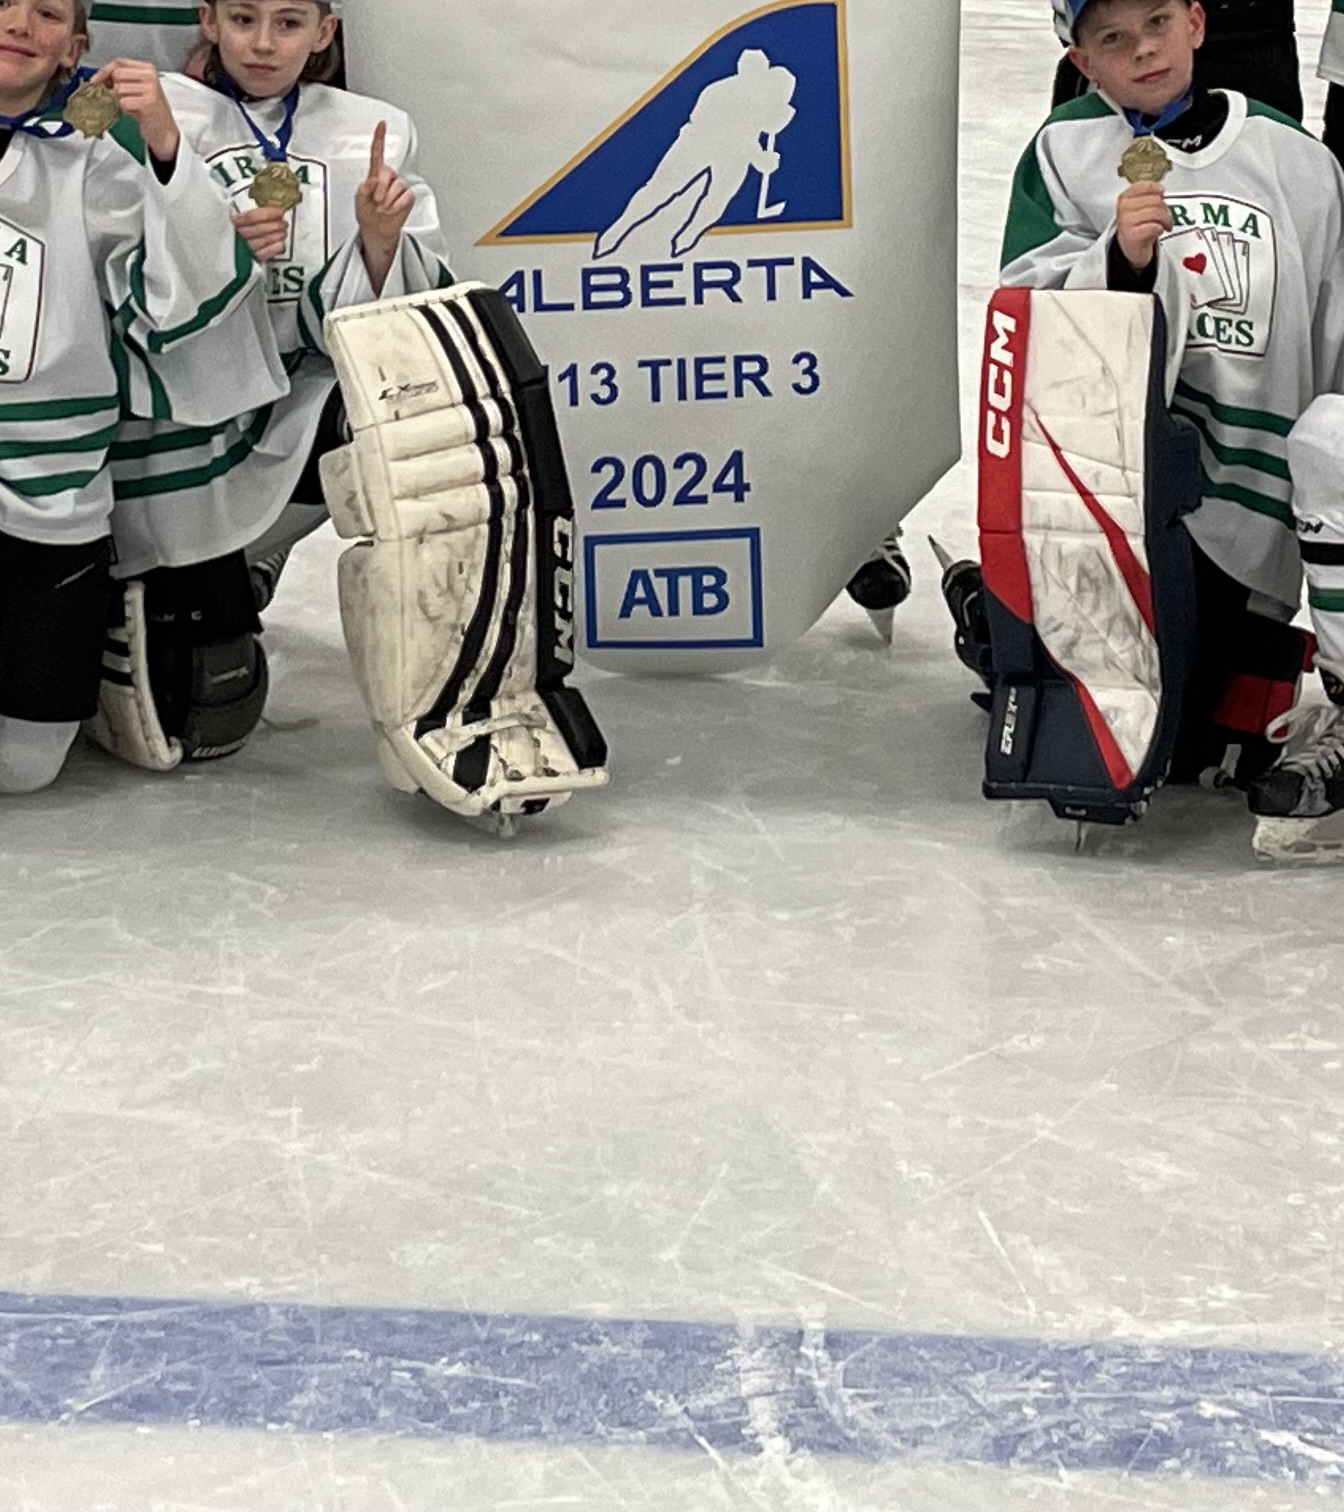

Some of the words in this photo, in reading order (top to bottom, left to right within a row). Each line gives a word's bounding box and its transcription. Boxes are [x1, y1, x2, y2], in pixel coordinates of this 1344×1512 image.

[1167, 202, 1262, 239] RMA
[498, 256, 855, 313] ALBERTA
[1190, 311, 1255, 348] CES
[545, 360, 620, 407] 13
[638, 353, 773, 404] TIER
[791, 351, 821, 396] 3
[985, 309, 1017, 460] CCM
[590, 449, 752, 511] 2024
[618, 565, 730, 619] ATB
